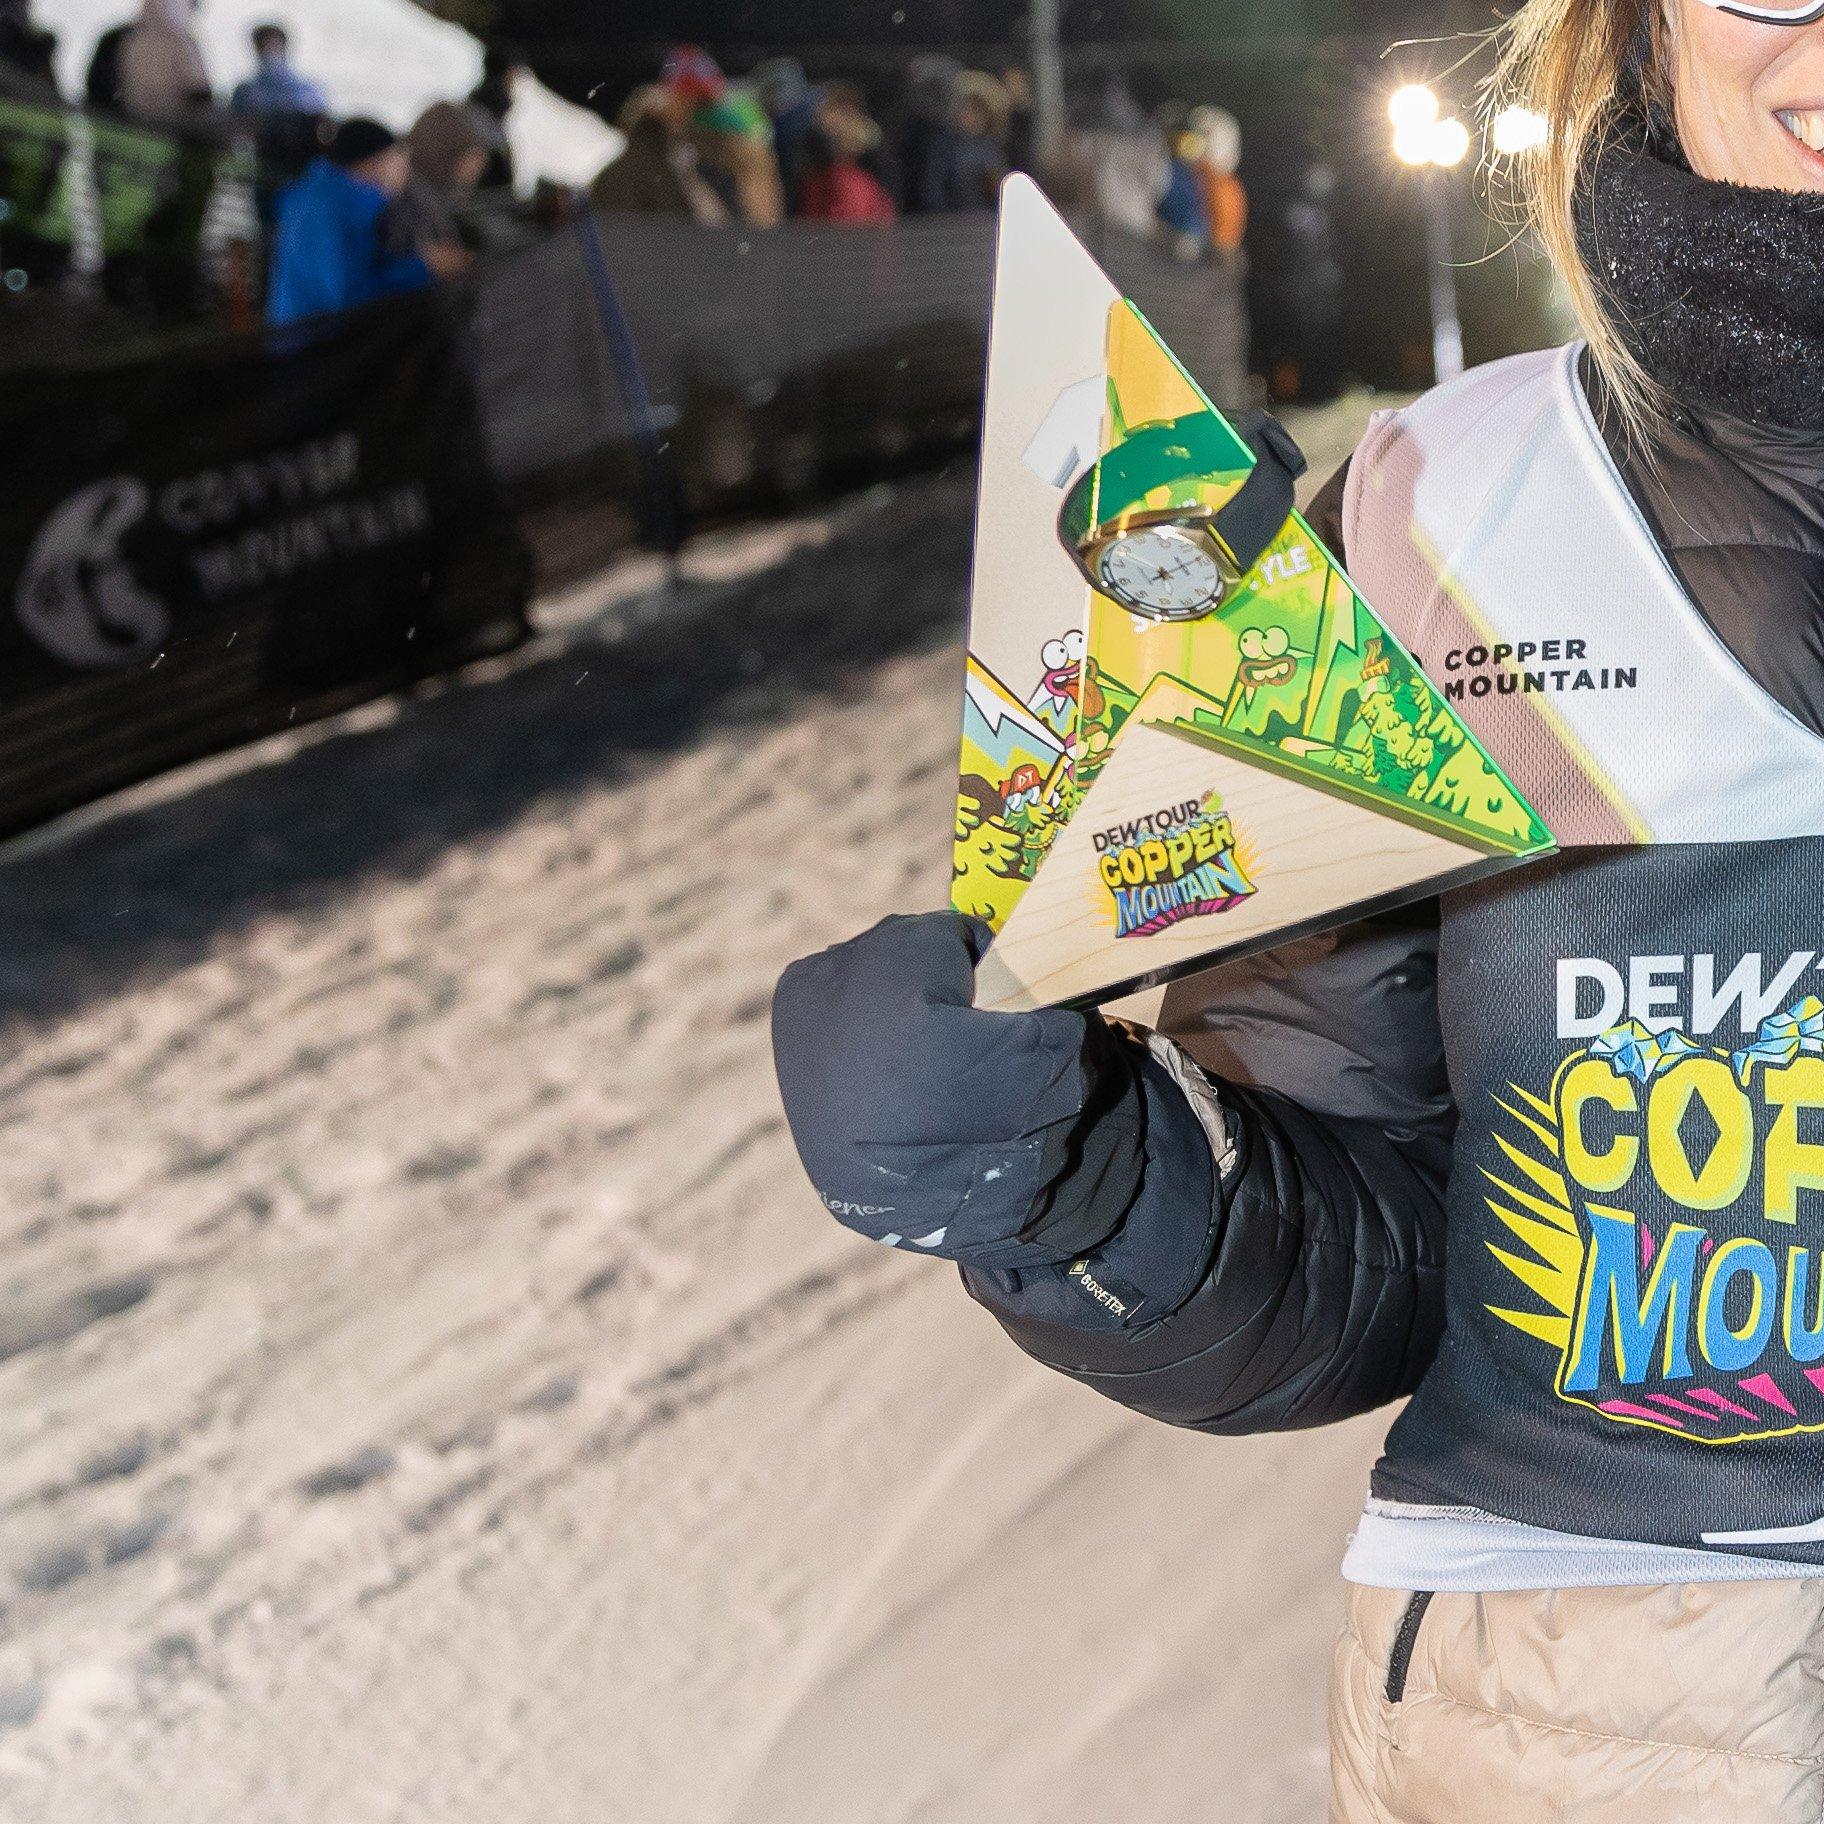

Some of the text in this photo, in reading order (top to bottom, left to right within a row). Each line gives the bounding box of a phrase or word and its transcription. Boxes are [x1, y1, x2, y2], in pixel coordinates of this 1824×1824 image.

[1444, 638, 1588, 672] COPPER
[1443, 666, 1638, 702] MOUNTAIN
[1101, 817, 1236, 887] COPPER
[1113, 847, 1258, 939] MOUNTAIN
